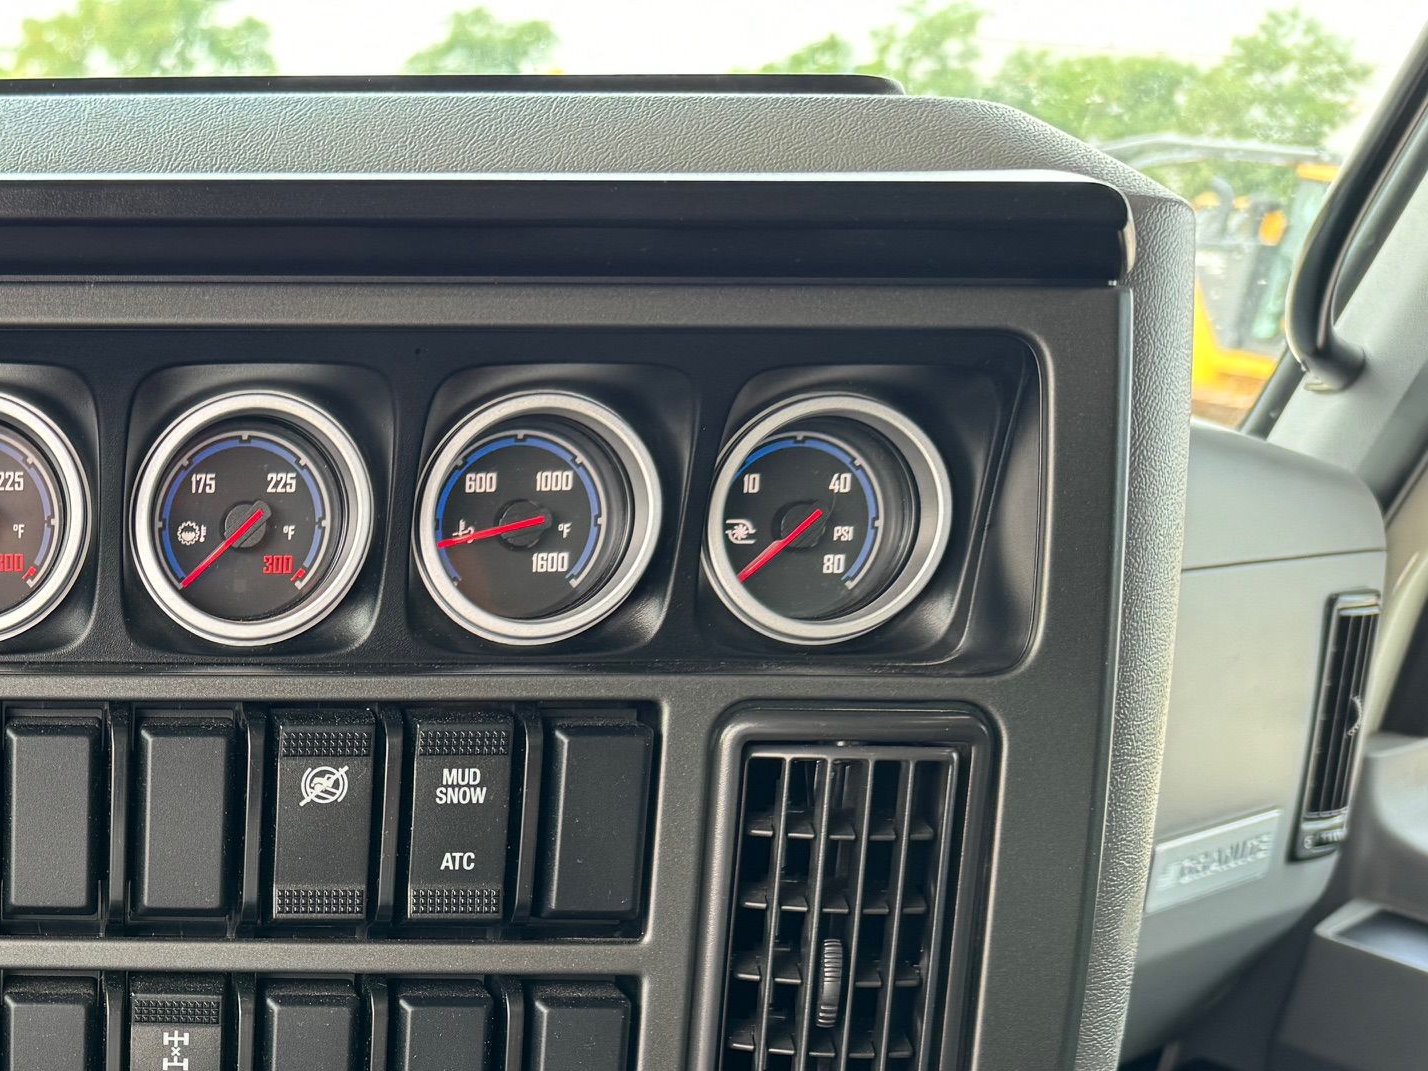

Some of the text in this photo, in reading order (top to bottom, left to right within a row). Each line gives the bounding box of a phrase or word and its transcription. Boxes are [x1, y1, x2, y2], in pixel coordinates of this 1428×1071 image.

[191, 474, 216, 494] 175
[267, 473, 296, 493] 225
[465, 473, 497, 493] 600
[536, 472, 573, 491] 1000
[743, 474, 760, 494] 10
[828, 473, 851, 492] 40
[833, 526, 853, 541] PSI
[262, 555, 293, 574] 300
[532, 553, 568, 572] 1600
[822, 554, 844, 574] 80
[442, 768, 481, 785] MUD
[435, 787, 486, 804] SNOW
[440, 853, 475, 870] ATC
